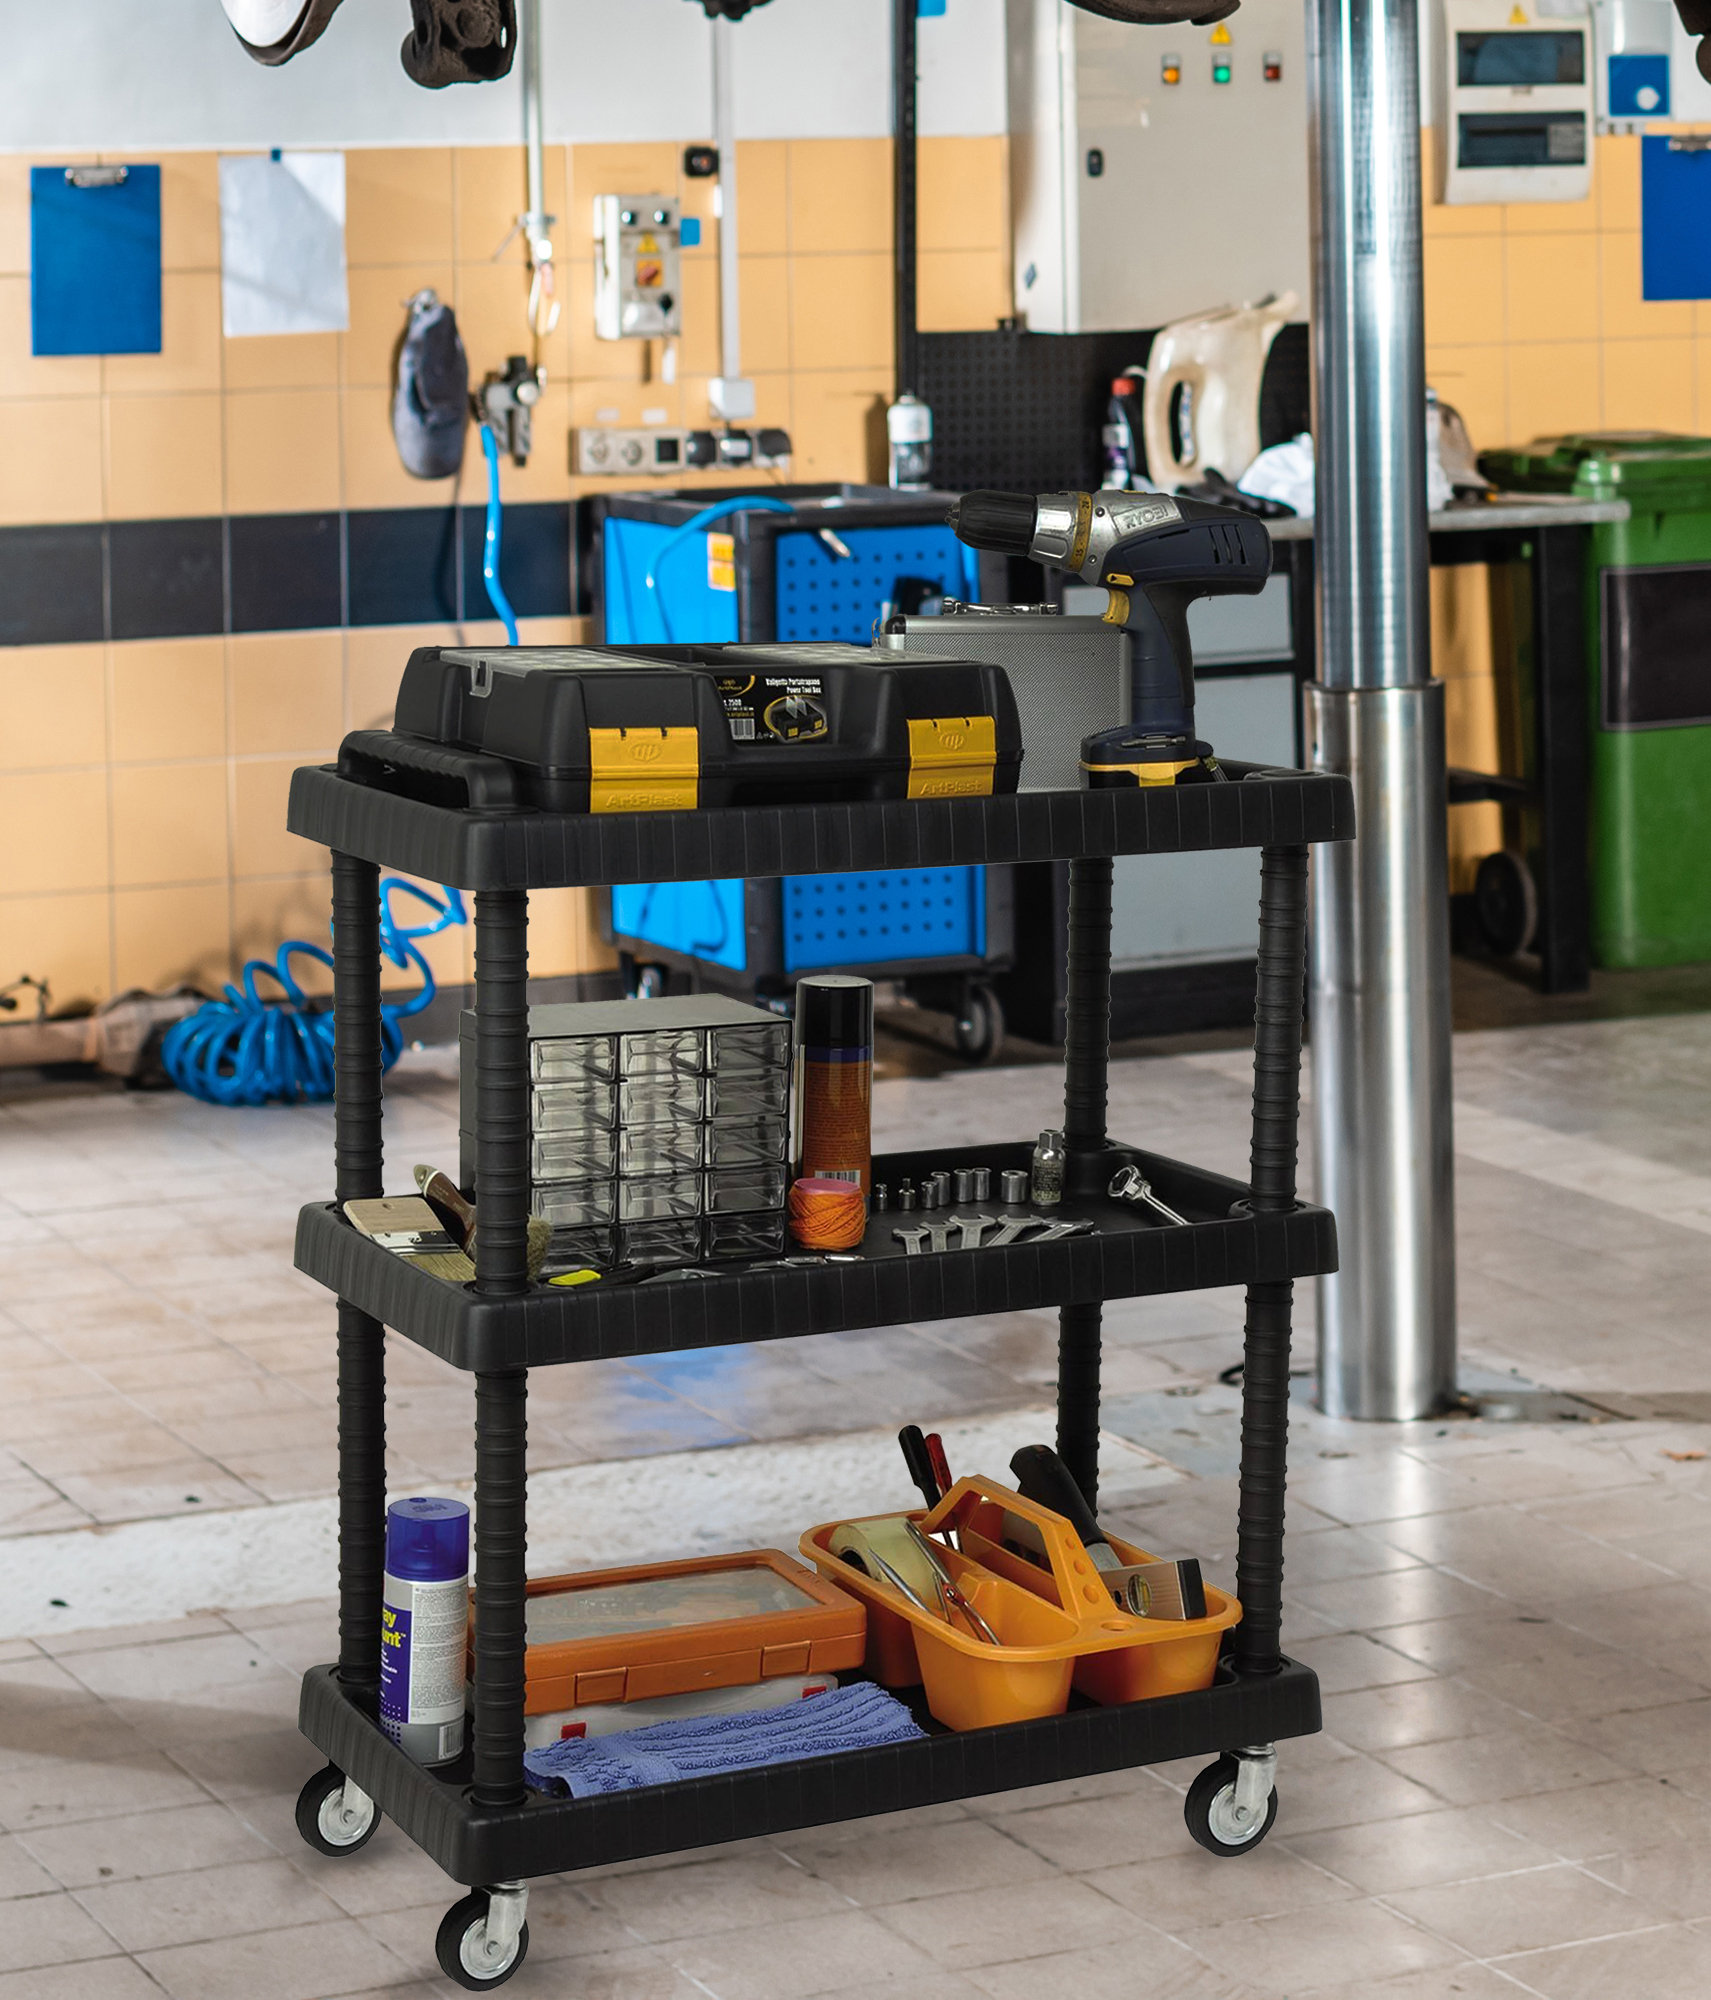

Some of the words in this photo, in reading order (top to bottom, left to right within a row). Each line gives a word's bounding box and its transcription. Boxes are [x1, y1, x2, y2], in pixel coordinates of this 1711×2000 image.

[1124, 504, 1169, 529] RYOBI
[802, 686, 812, 694] Tool
[812, 686, 822, 694] Box
[919, 779, 982, 797] ArtPlast
[605, 792, 683, 808] ArtPlast
